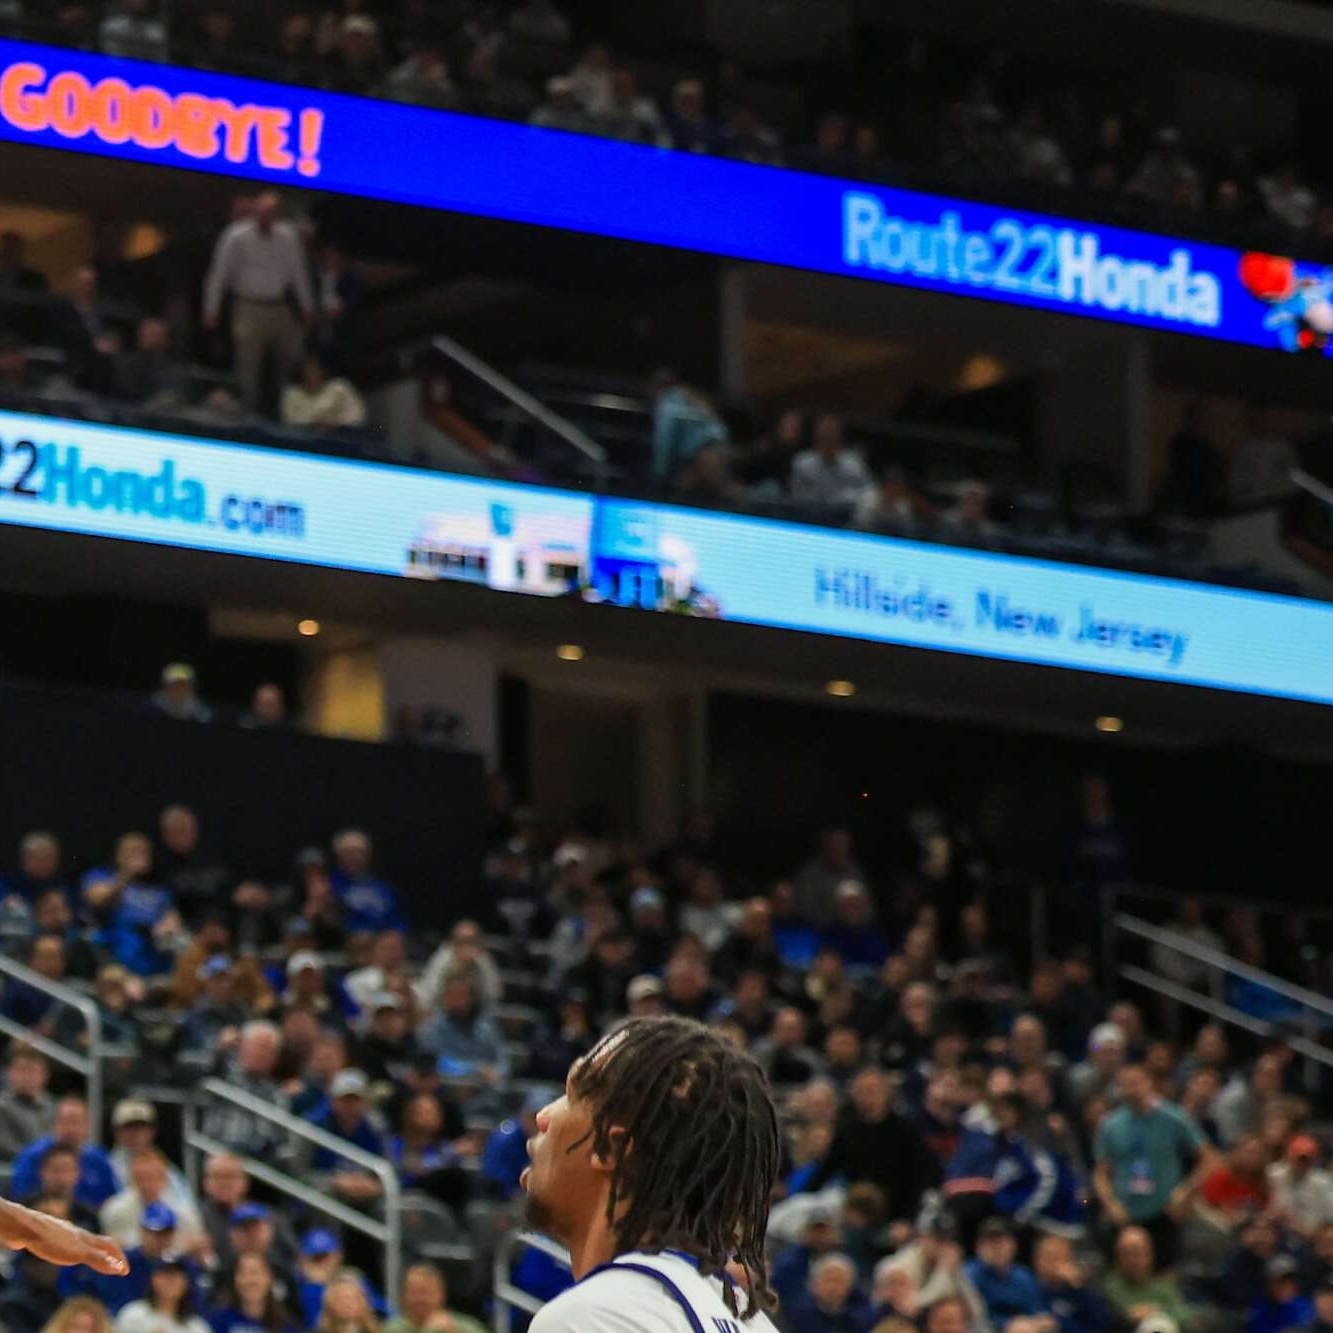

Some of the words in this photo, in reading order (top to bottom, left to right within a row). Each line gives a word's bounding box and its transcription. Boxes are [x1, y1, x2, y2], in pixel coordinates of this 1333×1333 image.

[842, 190, 1222, 328] Route22Honda
[974, 588, 1061, 641] New
[1070, 600, 1191, 668] Jersey
